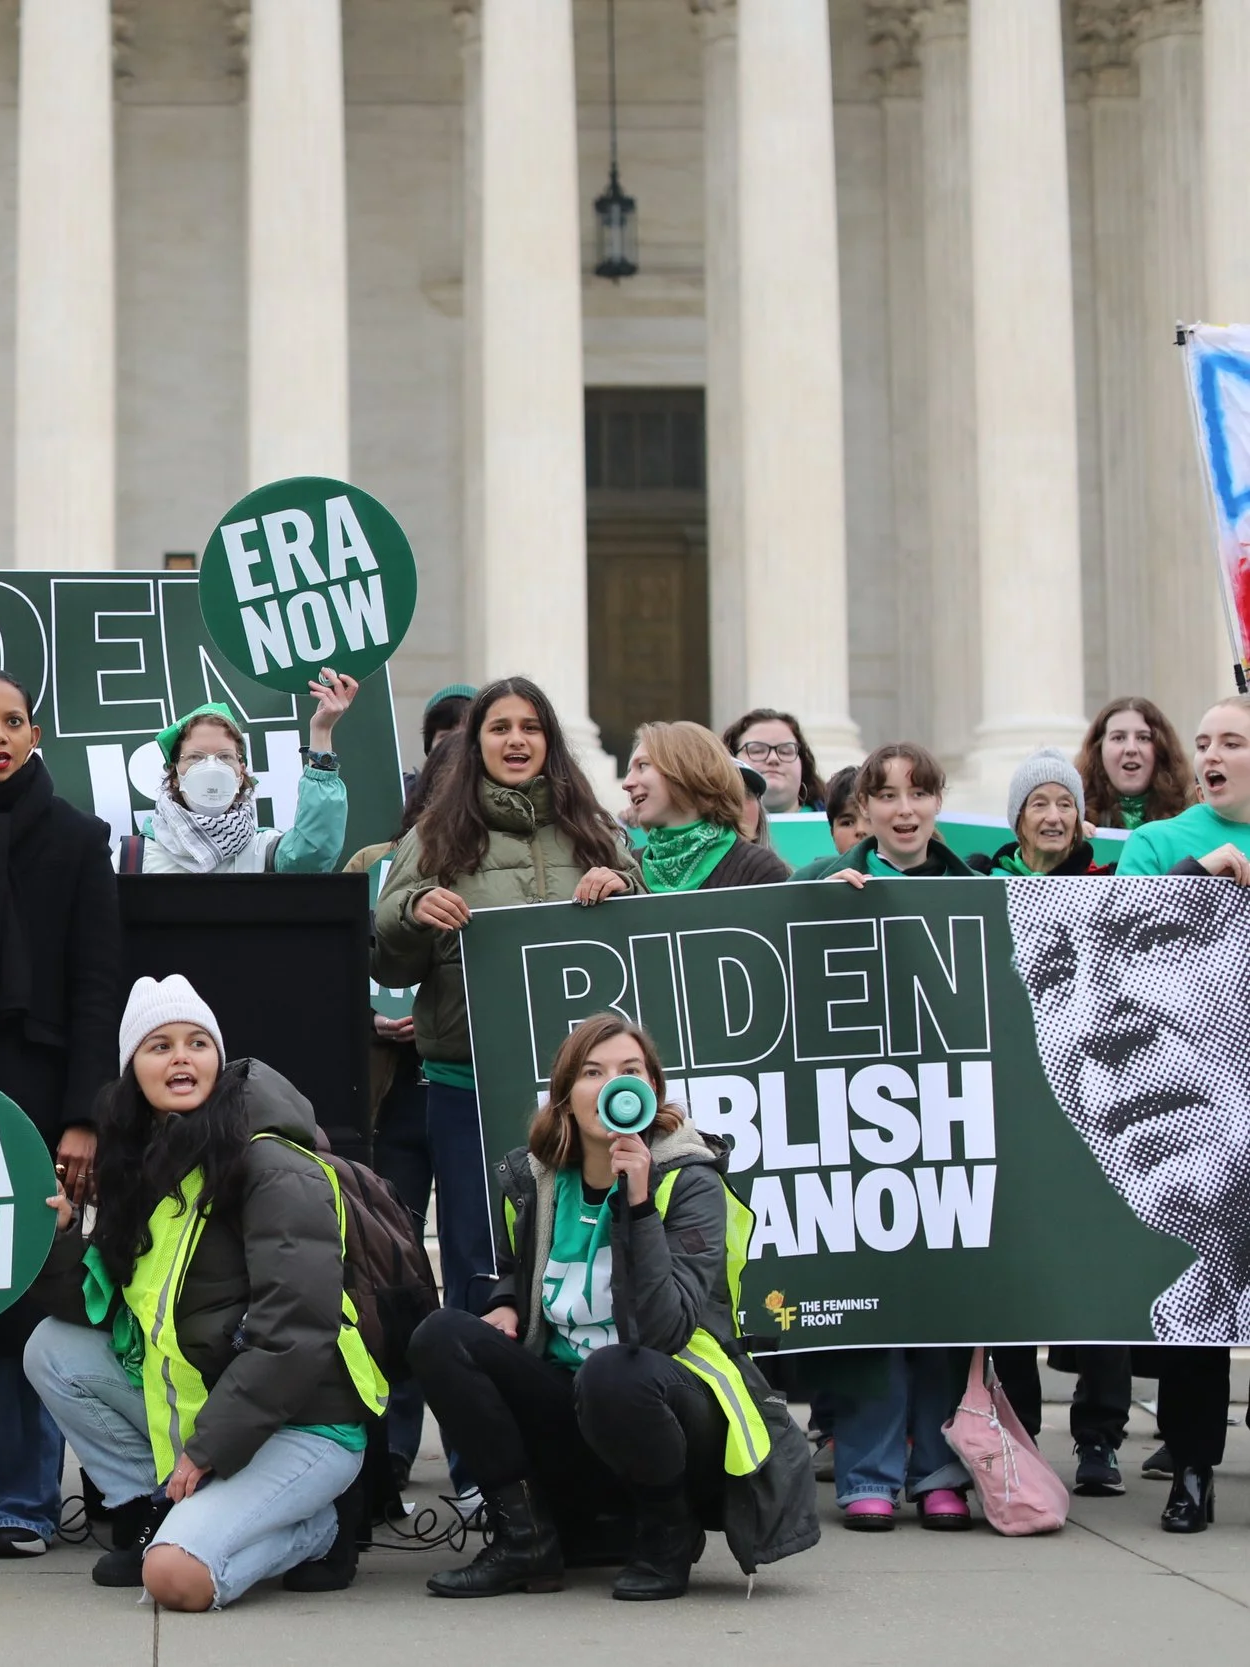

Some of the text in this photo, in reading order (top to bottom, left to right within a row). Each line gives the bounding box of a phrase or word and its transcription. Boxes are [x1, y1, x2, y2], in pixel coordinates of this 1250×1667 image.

[220, 495, 379, 603] ERA
[239, 574, 390, 676] NOW
[521, 915, 992, 1084] BIDEN
[537, 1060, 996, 1174] BLISH
[748, 1164, 998, 1260] ANOW
[799, 1298, 880, 1314] THE FEMINIST
[801, 1313, 844, 1327] FRONT
